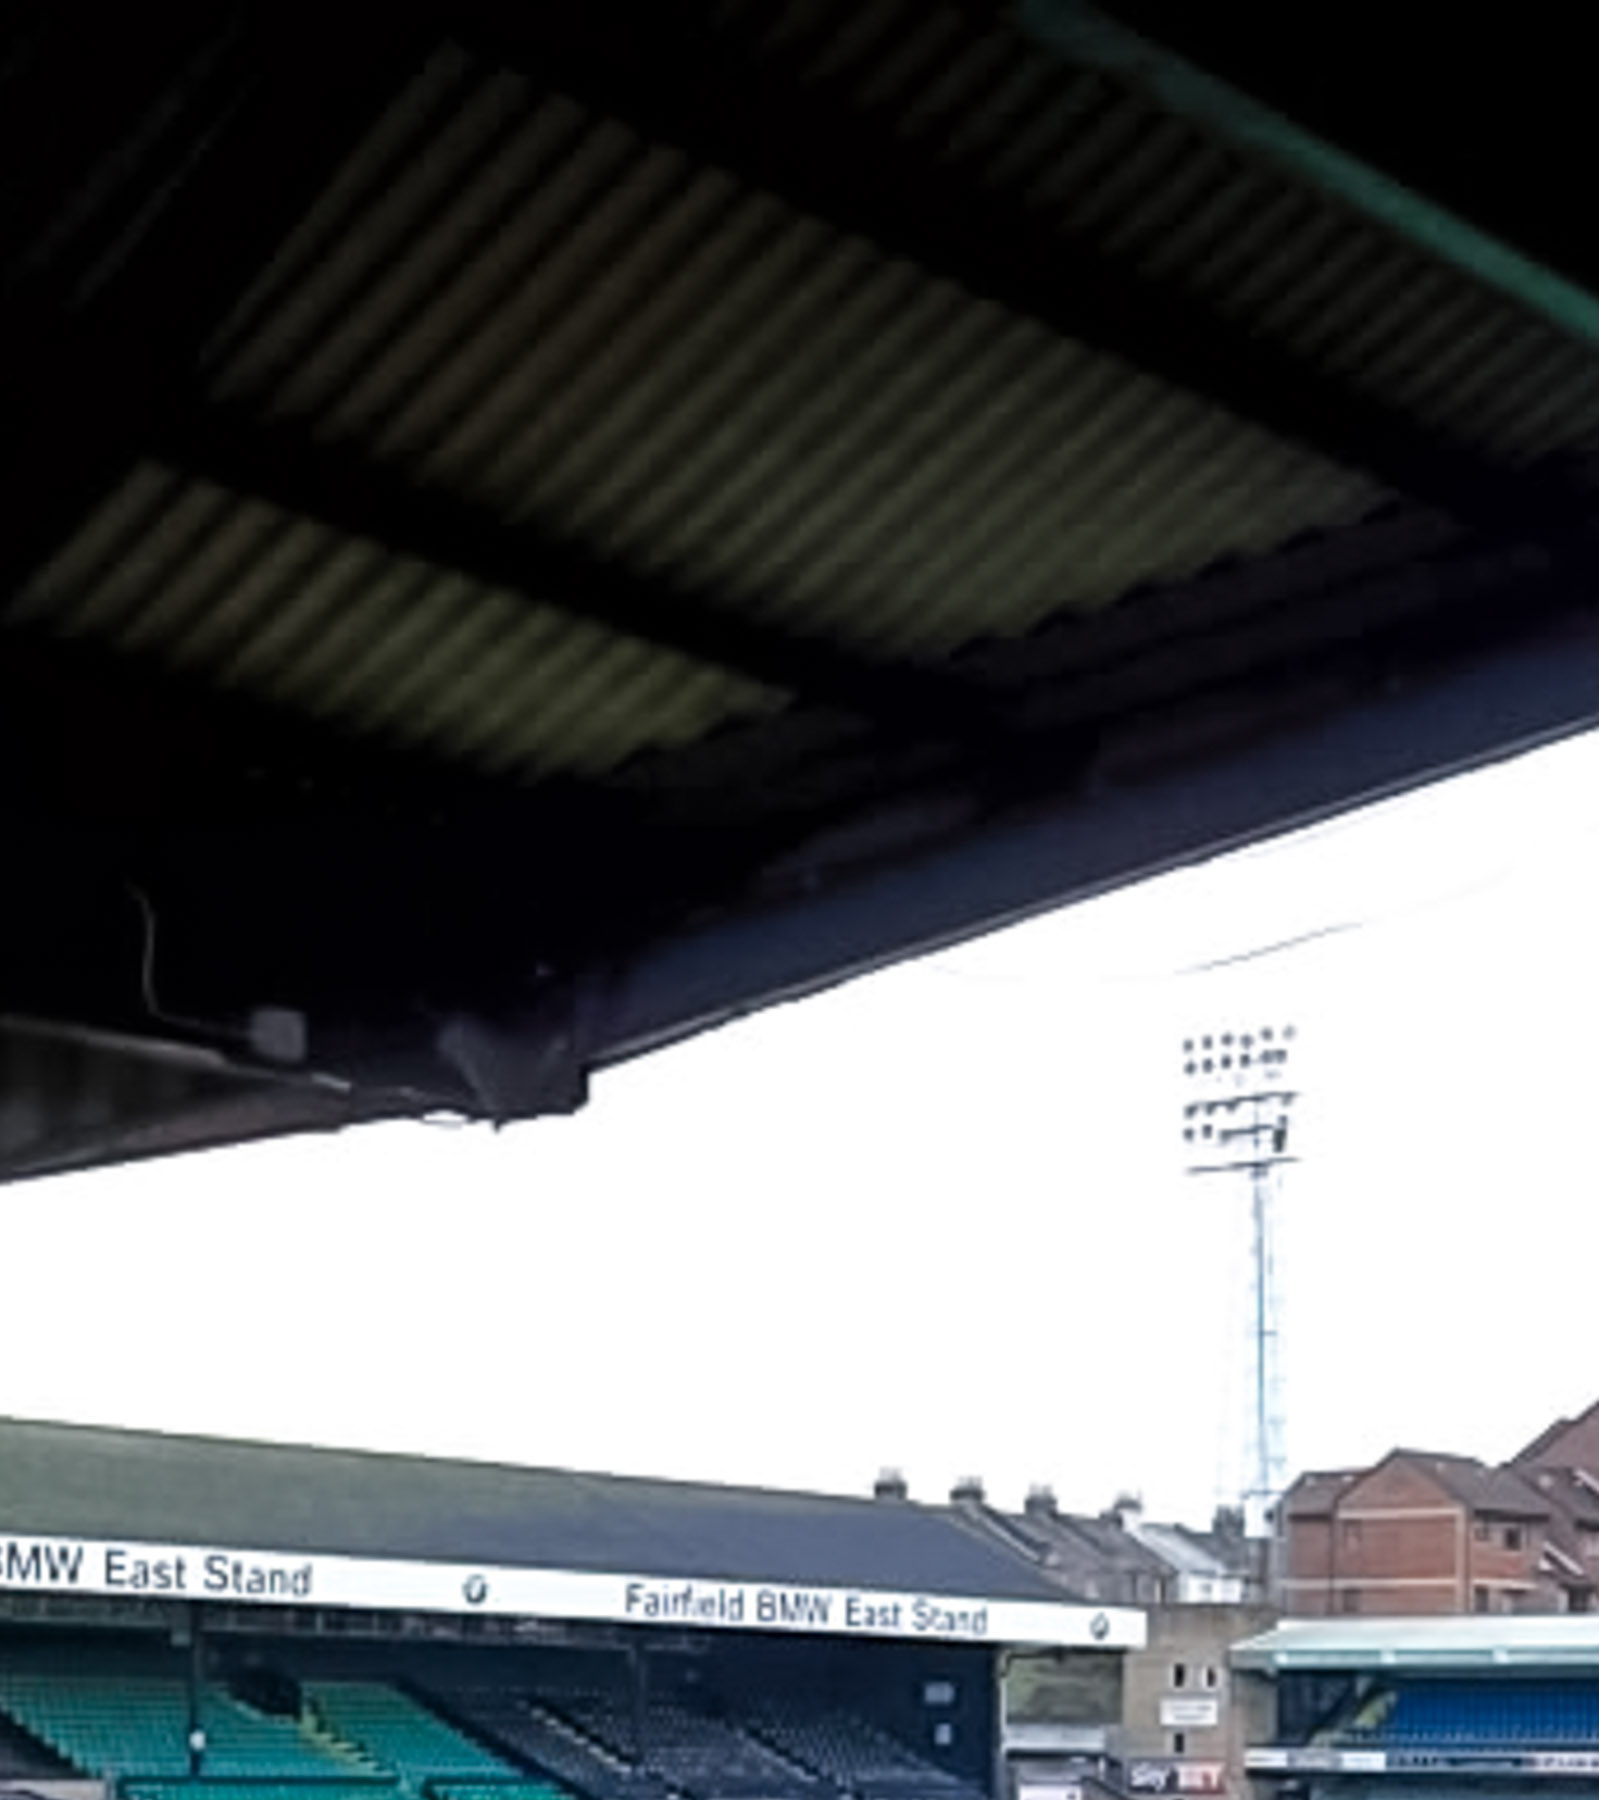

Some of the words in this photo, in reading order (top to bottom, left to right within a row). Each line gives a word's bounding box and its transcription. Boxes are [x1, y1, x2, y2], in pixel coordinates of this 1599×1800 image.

[105, 1549, 187, 1591] East
[203, 1555, 313, 1597] Stand
[625, 1583, 745, 1621] Fairfield
[757, 1590, 833, 1623] BMW
[846, 1597, 902, 1629] East
[911, 1599, 989, 1635] Stand
